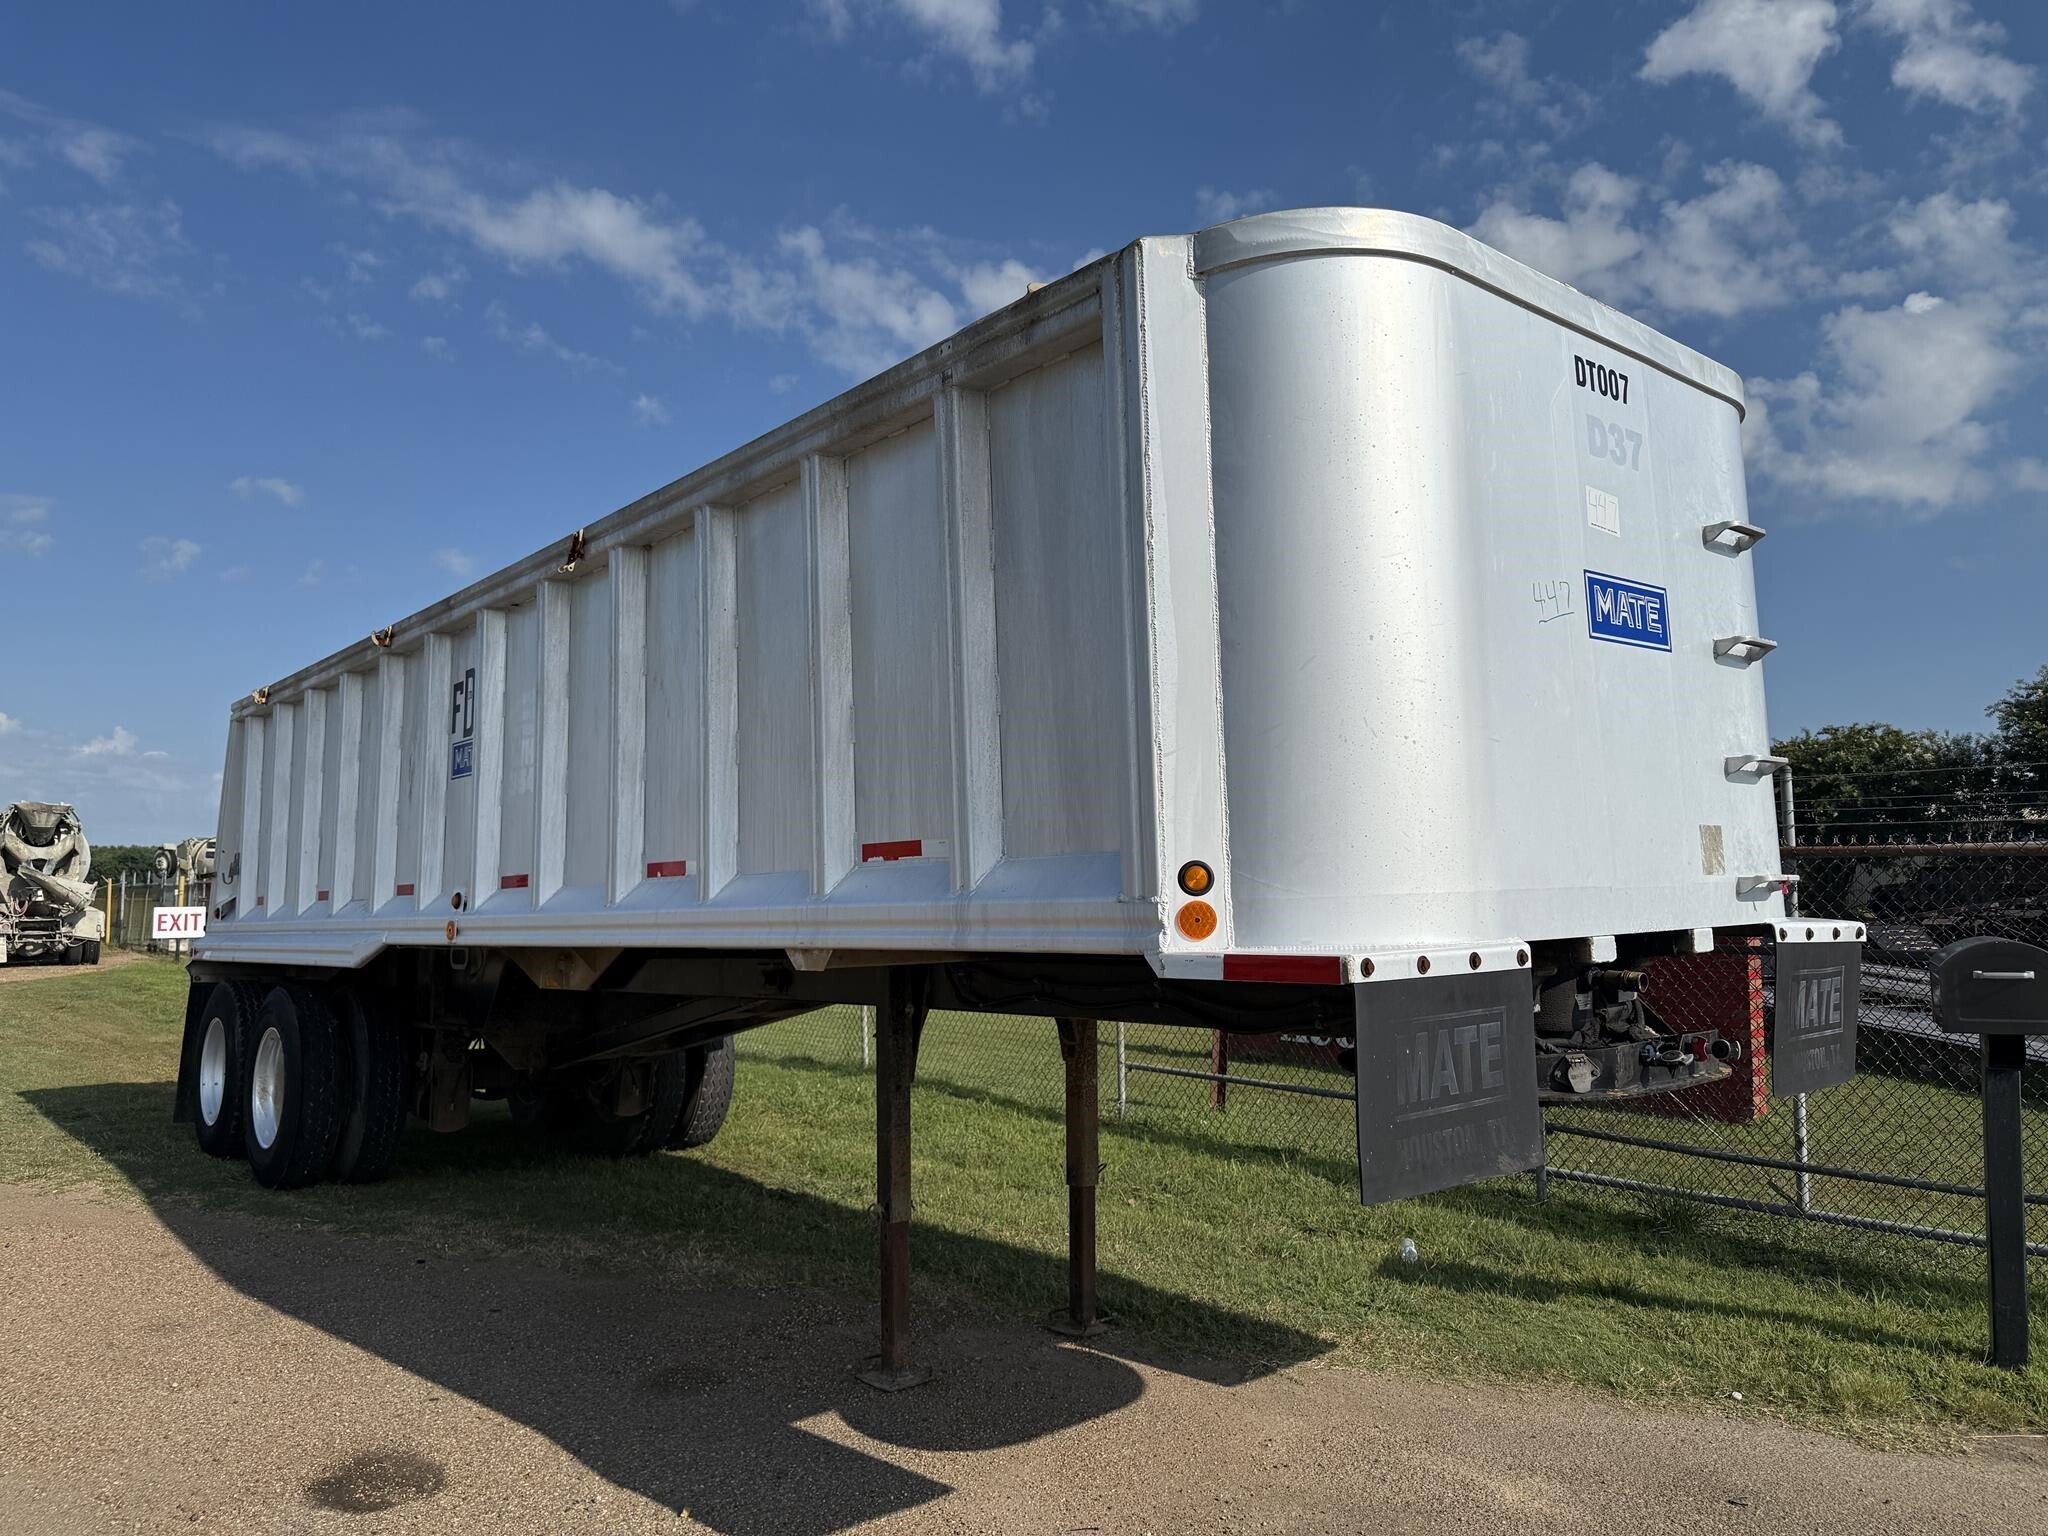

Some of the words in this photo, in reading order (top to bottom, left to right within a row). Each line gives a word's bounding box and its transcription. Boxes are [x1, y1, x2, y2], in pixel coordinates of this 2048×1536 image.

[1574, 354, 1629, 404] DT007
[1585, 413, 1643, 472] D37
[1532, 580, 1572, 615] 447
[1594, 584, 1663, 634] MATE
[454, 745, 473, 770] MAT
[157, 913, 202, 932] EXIT
[1792, 976, 1841, 1029] MATE
[1397, 1021, 1505, 1105] MATE
